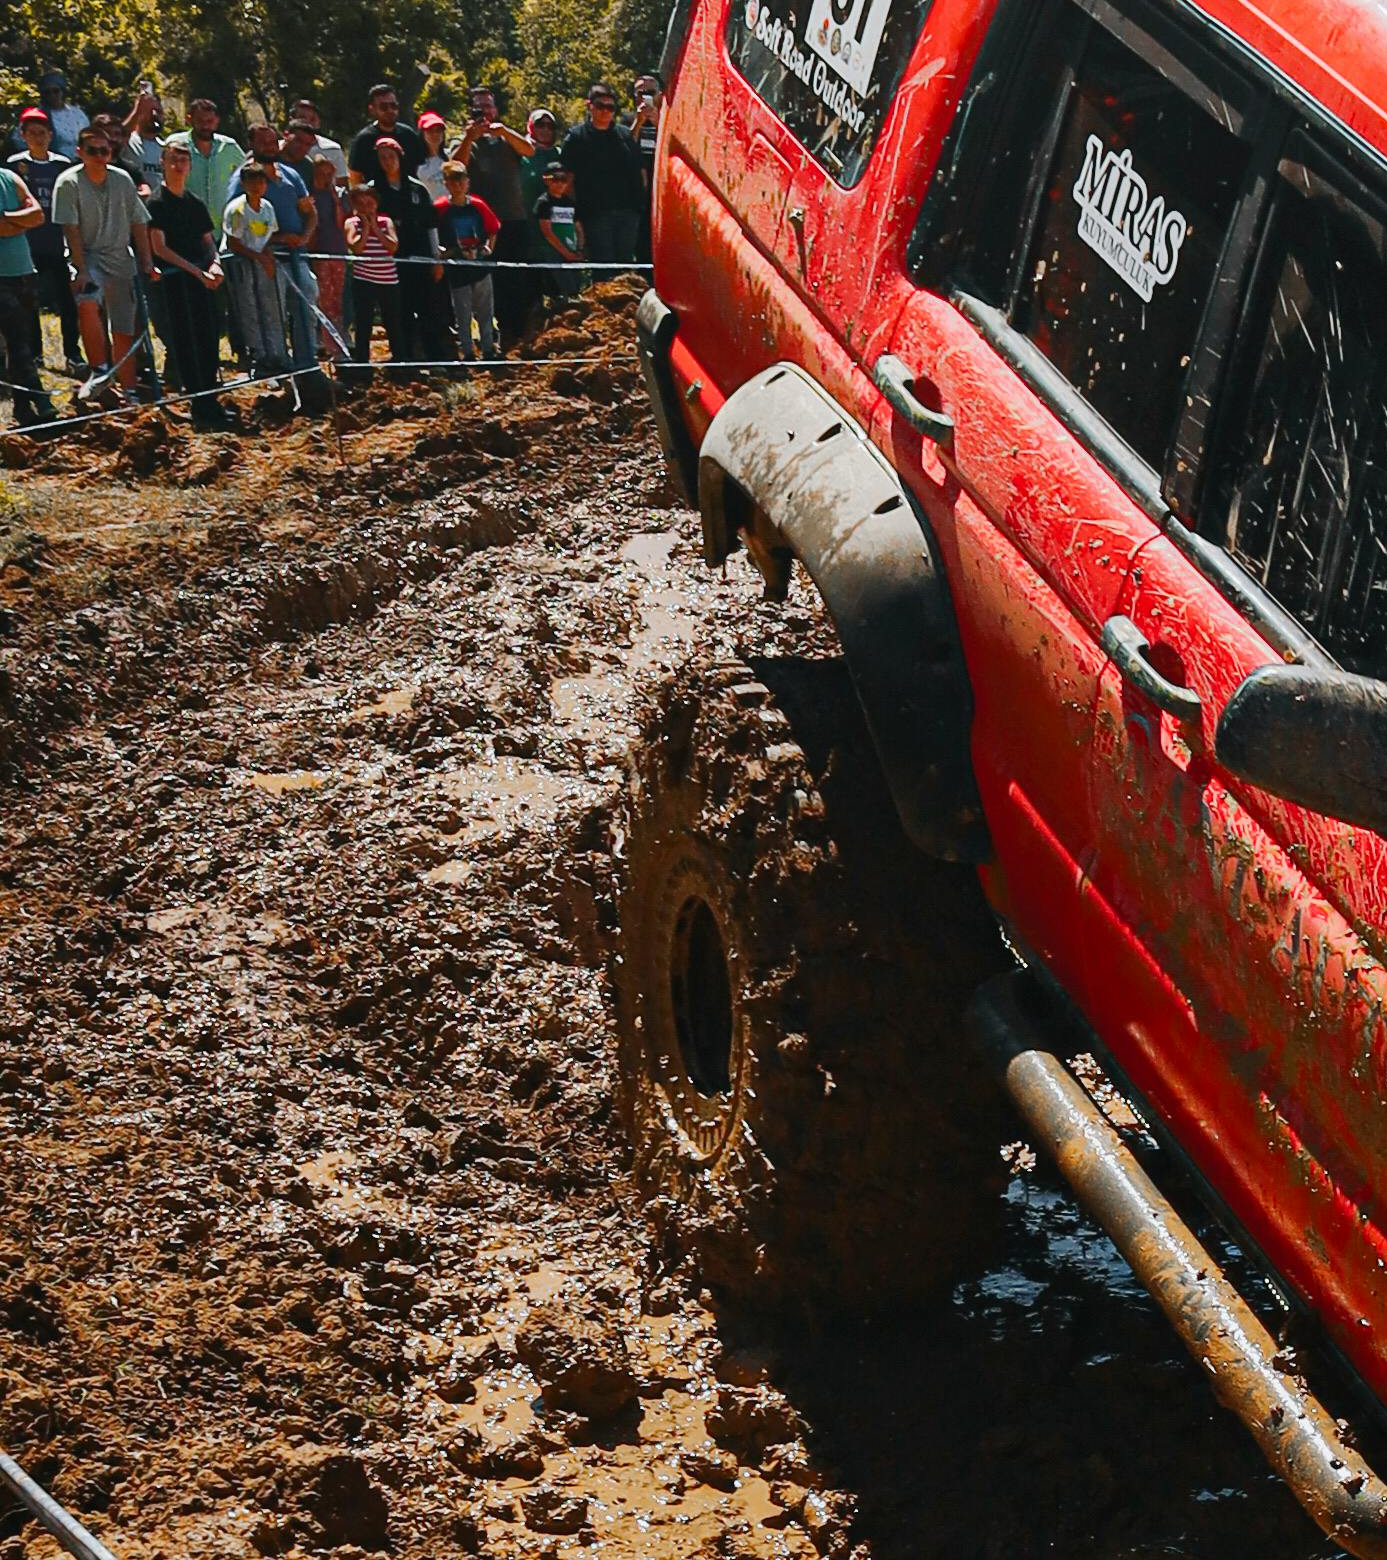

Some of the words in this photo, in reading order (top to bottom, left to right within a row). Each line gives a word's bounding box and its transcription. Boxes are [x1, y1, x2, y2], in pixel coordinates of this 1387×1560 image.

[756, 5, 783, 56] Soft
[778, 39, 811, 87] Road
[812, 56, 866, 134] Outdoor
[1078, 140, 1182, 276] MİRAS
[1082, 212, 1154, 293] KUYUMCULUK
